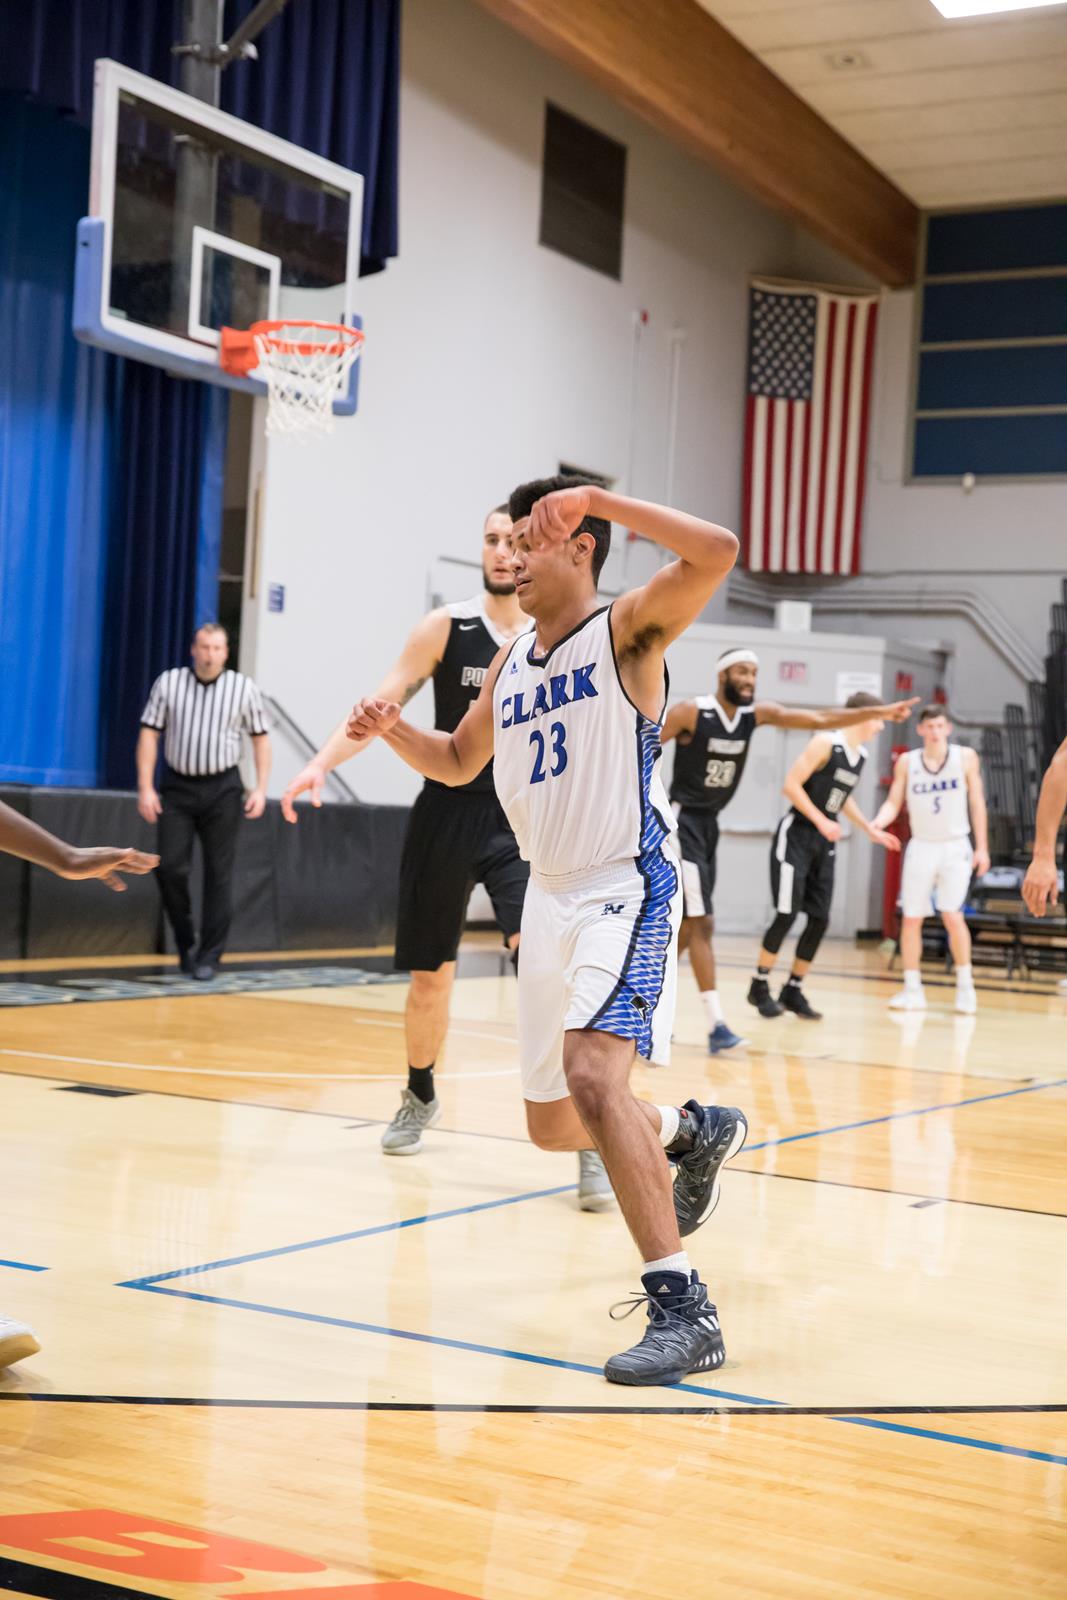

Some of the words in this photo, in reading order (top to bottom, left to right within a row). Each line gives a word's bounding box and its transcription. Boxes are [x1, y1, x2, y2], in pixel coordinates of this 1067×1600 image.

[501, 662, 598, 729] CLARK
[529, 721, 568, 784] 23
[912, 778, 958, 794] CLARK
[932, 796, 942, 814] 5
